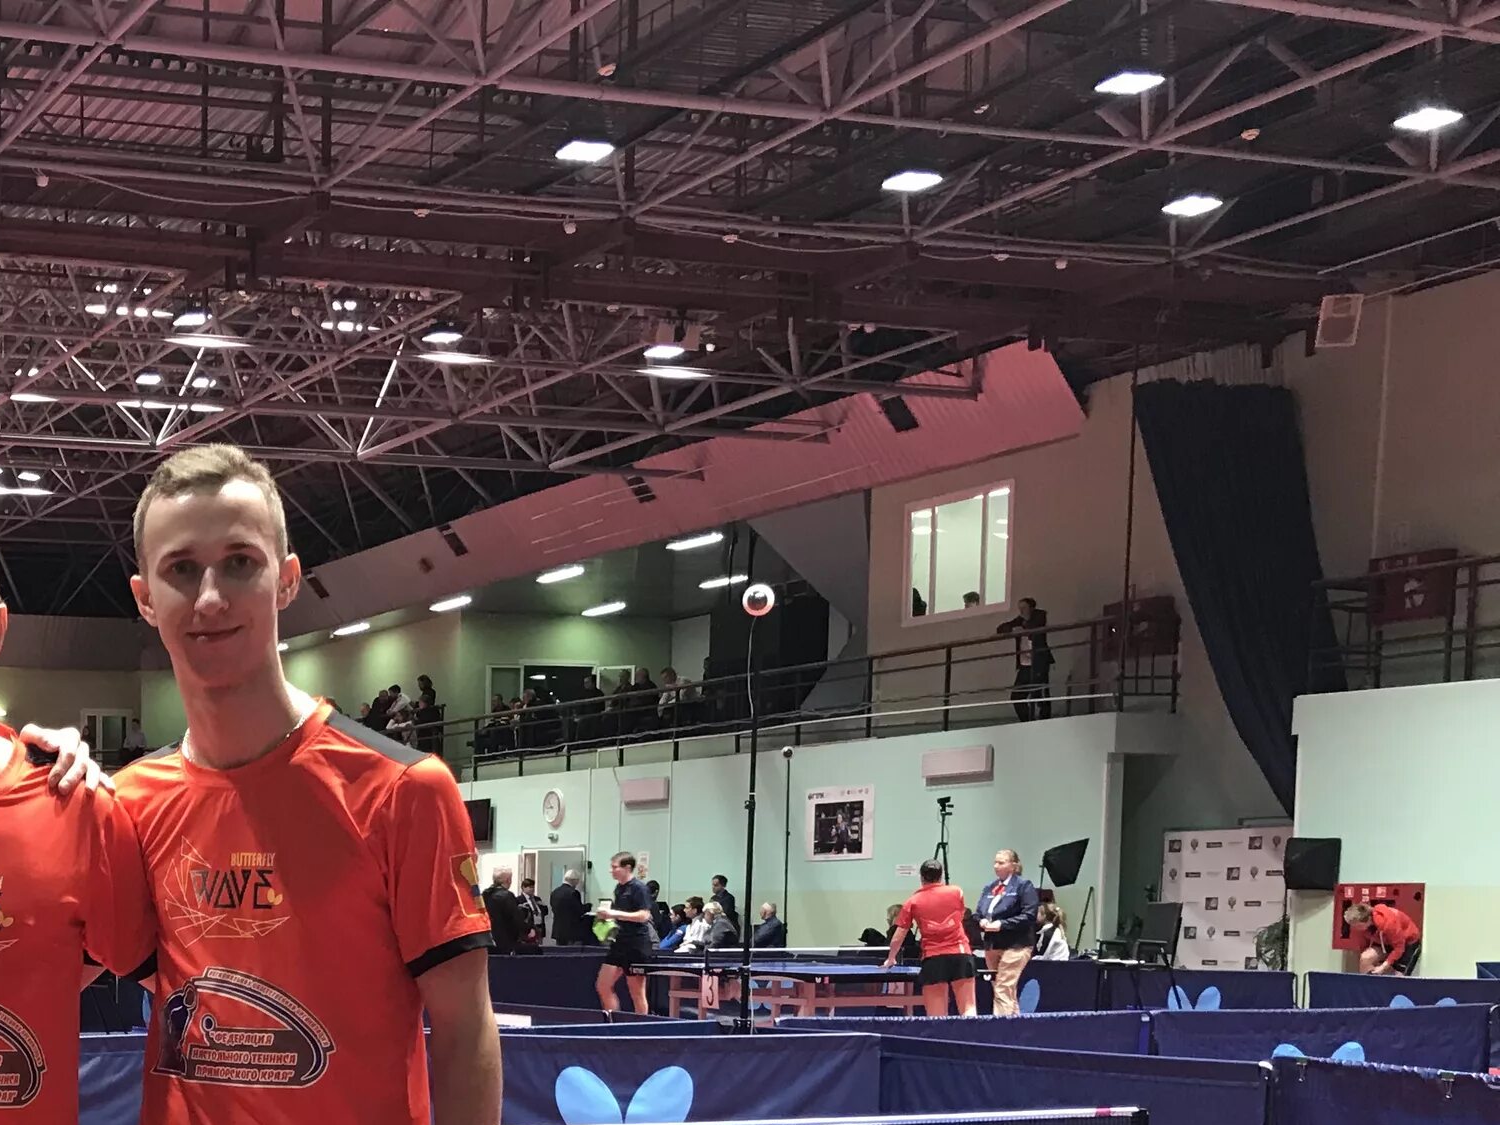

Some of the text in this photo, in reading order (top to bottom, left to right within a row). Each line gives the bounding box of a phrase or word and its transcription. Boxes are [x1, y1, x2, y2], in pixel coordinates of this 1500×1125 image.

[230, 852, 276, 868] BUTTERFLY
[190, 869, 275, 910] WAVE
[251, 1052, 298, 1065] ТЕННИСА
